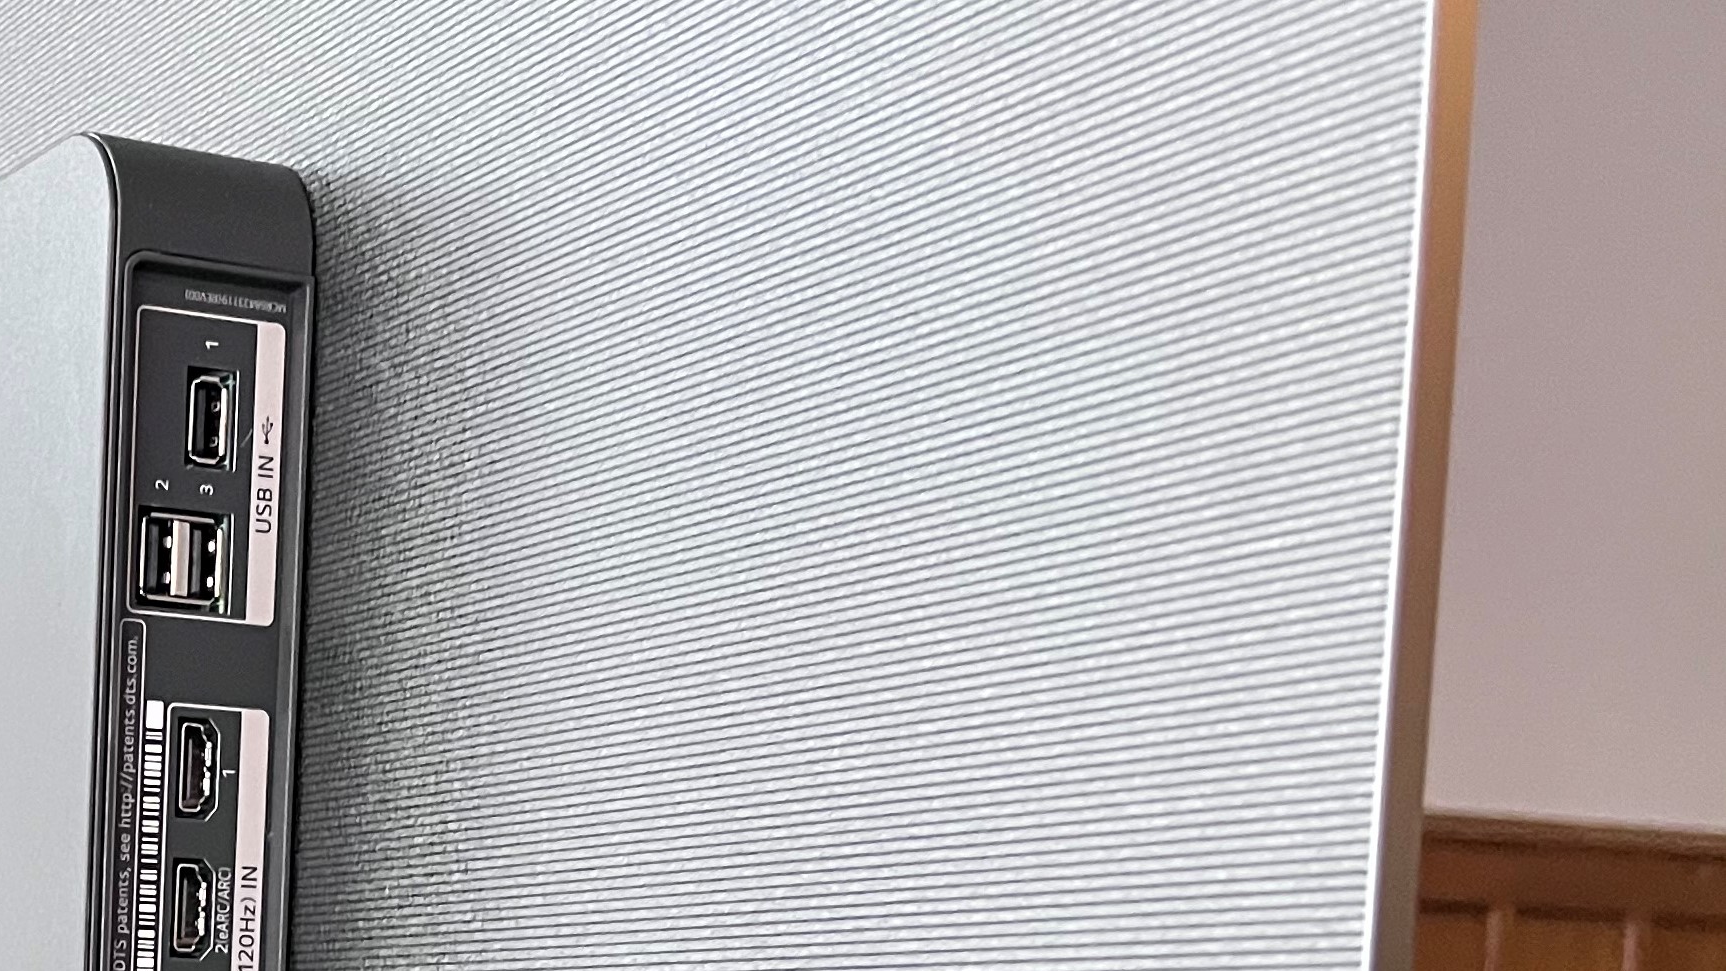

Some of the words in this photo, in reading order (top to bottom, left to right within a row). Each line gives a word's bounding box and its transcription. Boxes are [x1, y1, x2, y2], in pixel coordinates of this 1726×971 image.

[205, 340, 220, 350] 1
[257, 455, 274, 479] IN
[155, 479, 169, 491] 2
[199, 484, 214, 496] 3
[255, 488, 273, 534] USB
[222, 769, 236, 777] 1
[120, 833, 131, 862] see
[241, 865, 258, 889] IN
[116, 866, 132, 934] patents,
[113, 939, 128, 971] DTS
